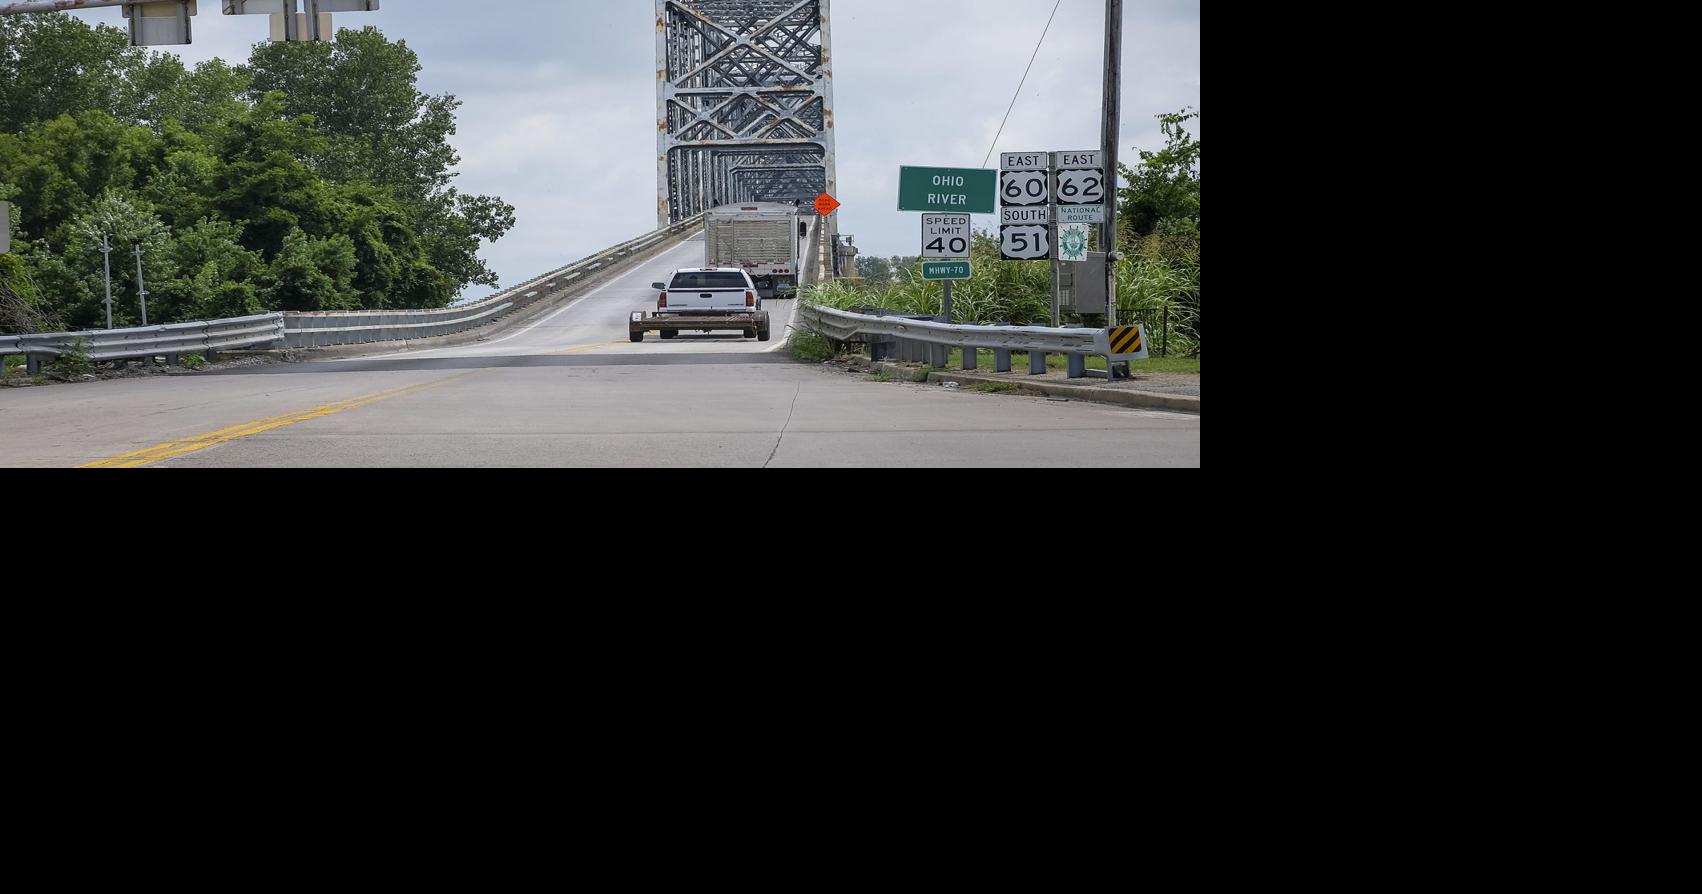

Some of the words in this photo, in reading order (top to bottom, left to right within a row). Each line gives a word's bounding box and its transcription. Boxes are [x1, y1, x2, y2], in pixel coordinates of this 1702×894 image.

[1008, 155, 1039, 167] EAST
[1063, 154, 1095, 165] EAST
[932, 175, 964, 187] OHIO
[1061, 177, 1099, 197] 62
[1004, 178, 1043, 198] 60
[927, 193, 967, 205] RIVER
[1004, 210, 1047, 221] SOUTH
[1061, 206, 1101, 214] NATIONAL
[926, 217, 966, 225] SPEED
[930, 227, 961, 235] LIMIT
[925, 236, 967, 254] 40
[1011, 232, 1041, 252] 51
